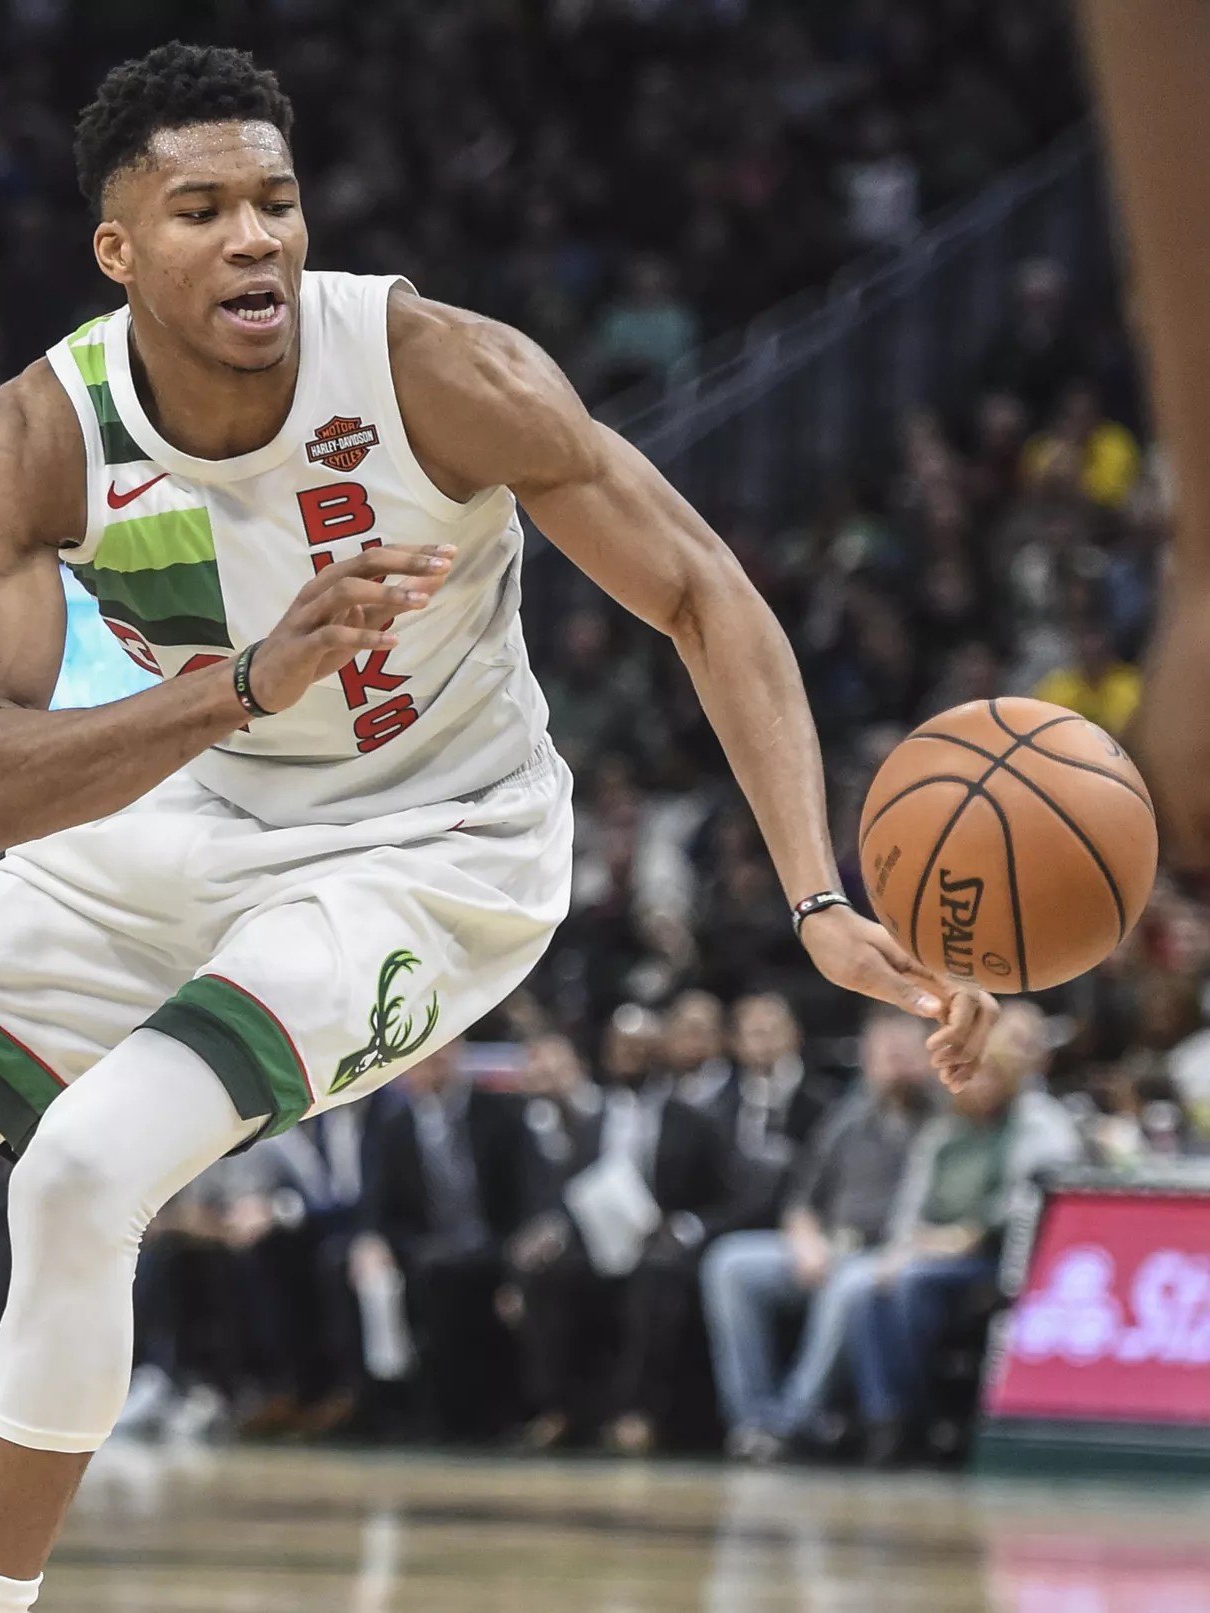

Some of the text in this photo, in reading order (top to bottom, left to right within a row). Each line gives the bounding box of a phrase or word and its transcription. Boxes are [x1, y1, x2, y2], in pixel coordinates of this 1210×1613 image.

[322, 421, 356, 439] MOTOR
[310, 429, 375, 458] HARLEY-DAVIDSON
[329, 449, 363, 468] CYCLES
[296, 481, 419, 753] BKS
